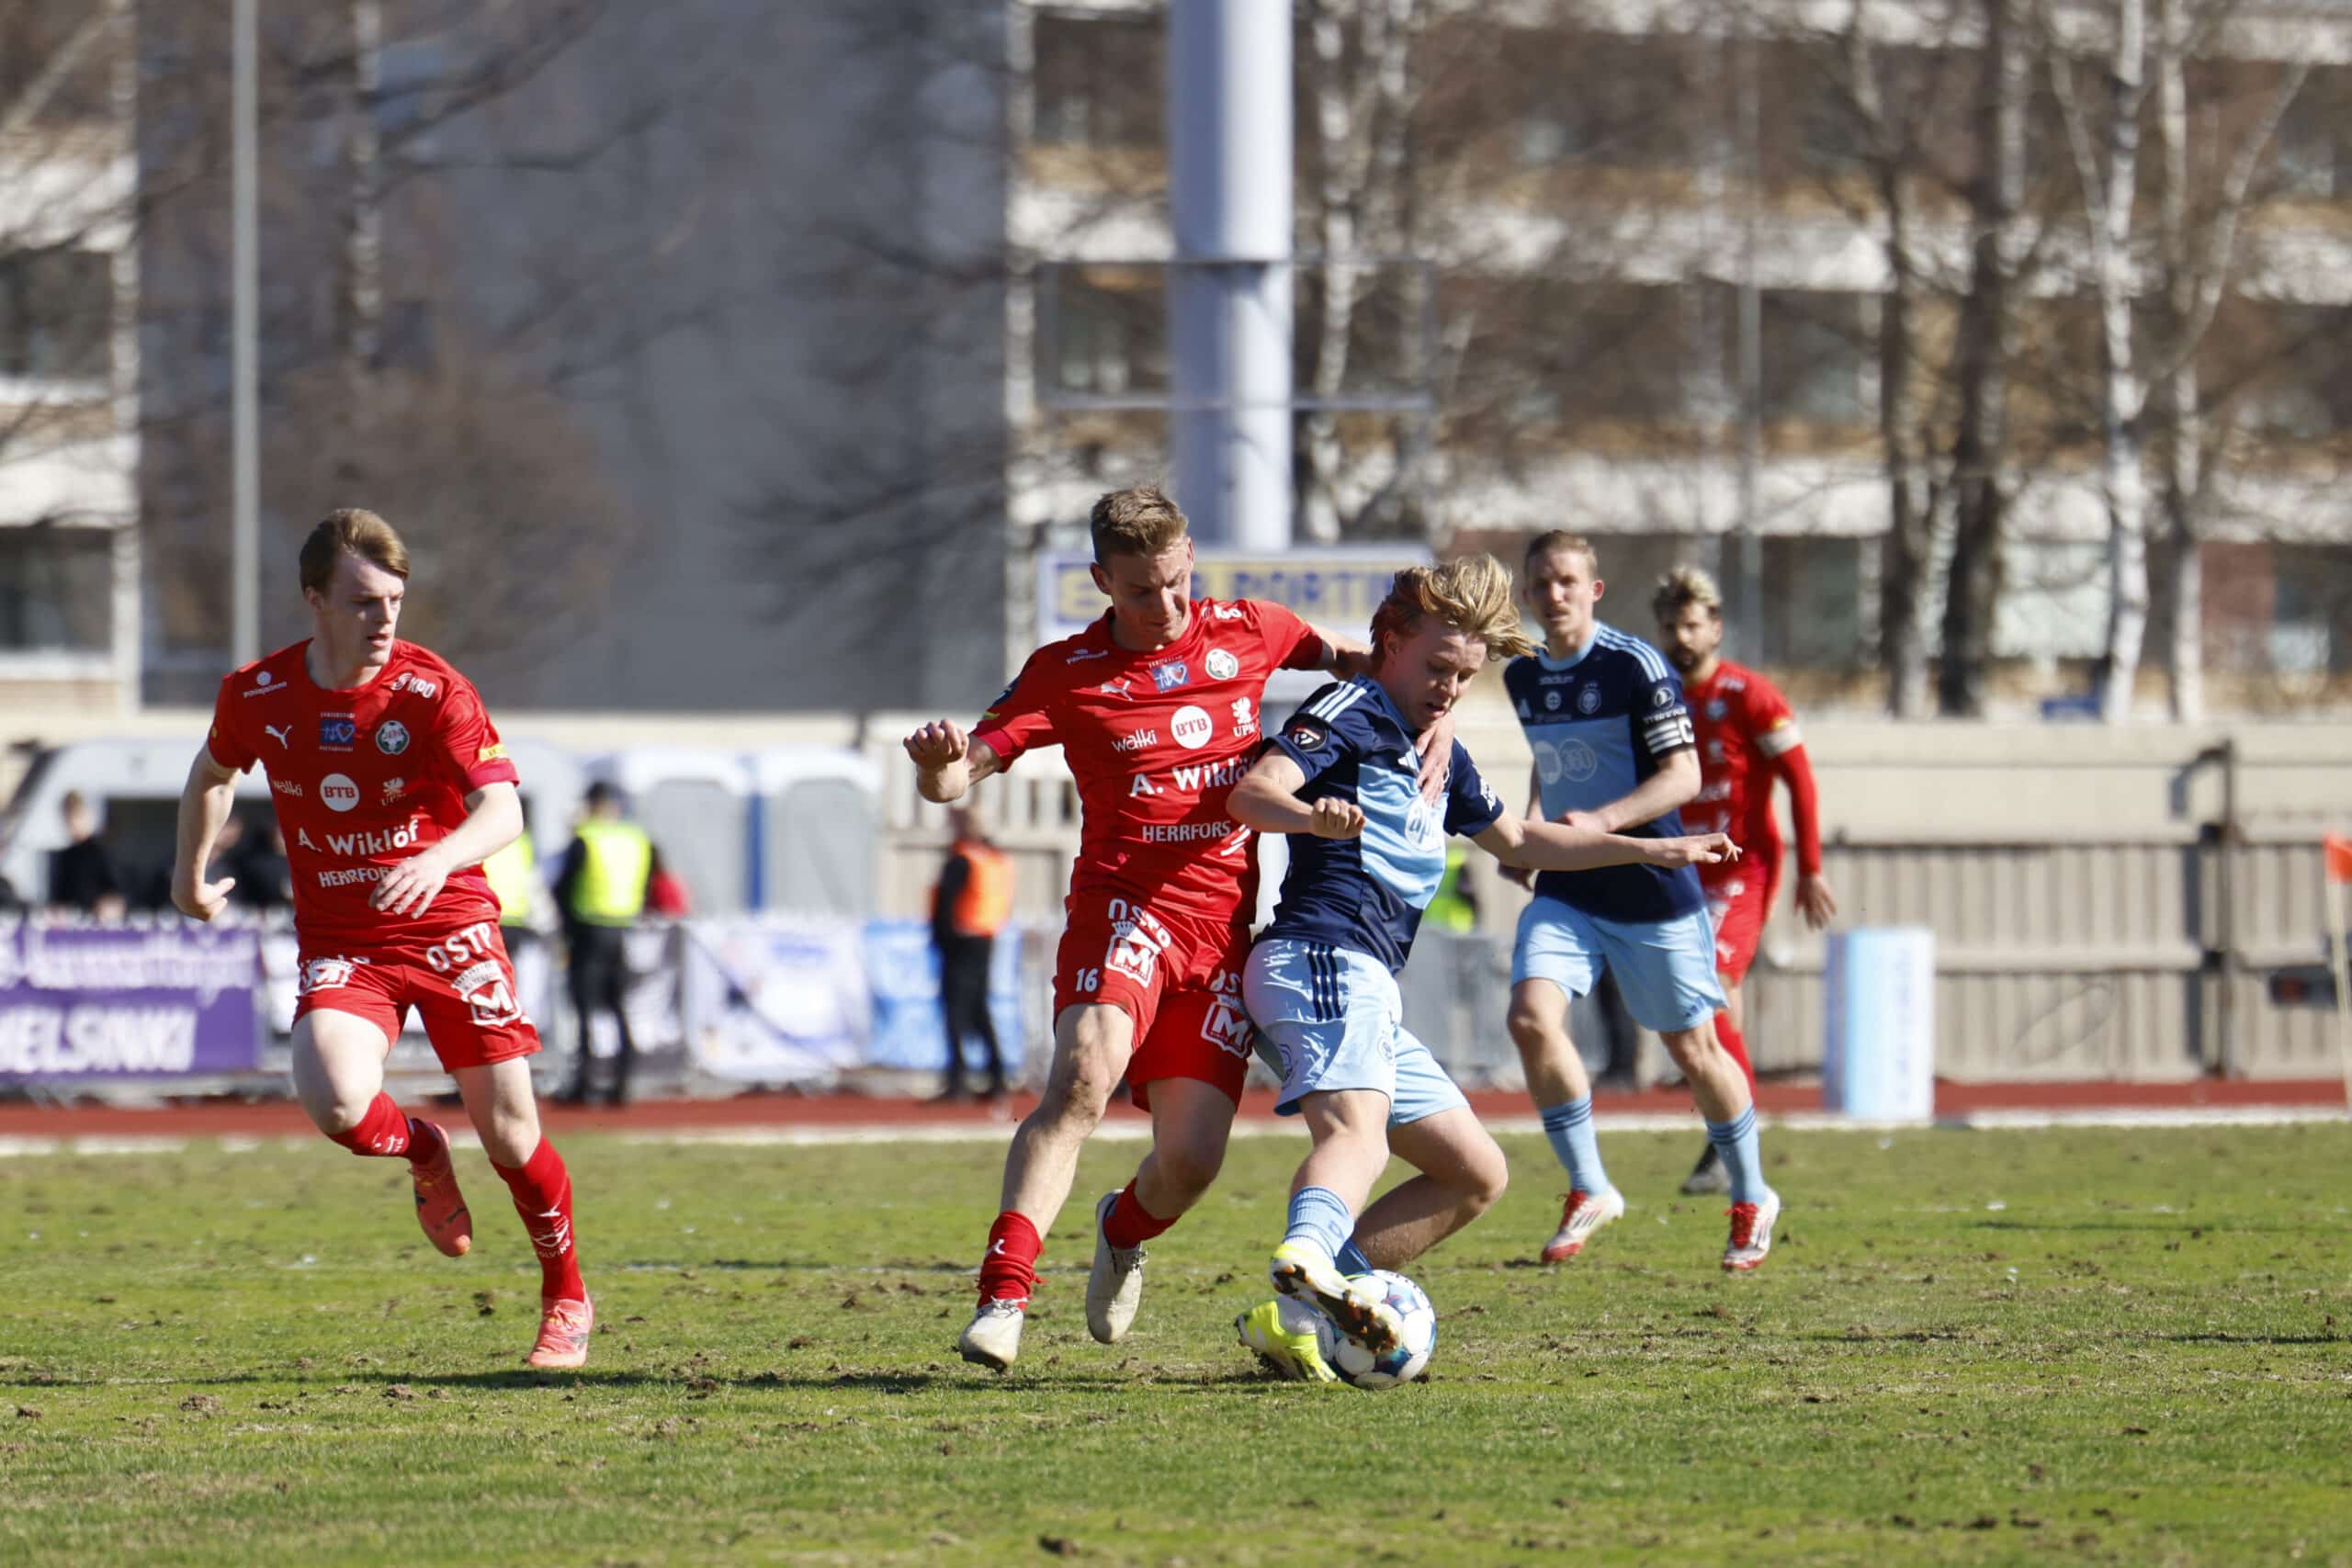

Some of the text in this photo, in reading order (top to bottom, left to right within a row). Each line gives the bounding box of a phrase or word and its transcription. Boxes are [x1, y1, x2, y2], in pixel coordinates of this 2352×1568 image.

[1175, 717, 1209, 737] BTB
[1111, 728, 1158, 752] walki
[1129, 755, 1259, 797] A. Wiklö
[324, 785, 356, 798] BTB
[298, 818, 419, 856] A. Wiklöf
[1142, 819, 1232, 843] HERRFORS
[317, 866, 398, 888] HERRFOR
[1075, 968, 1099, 992] 16
